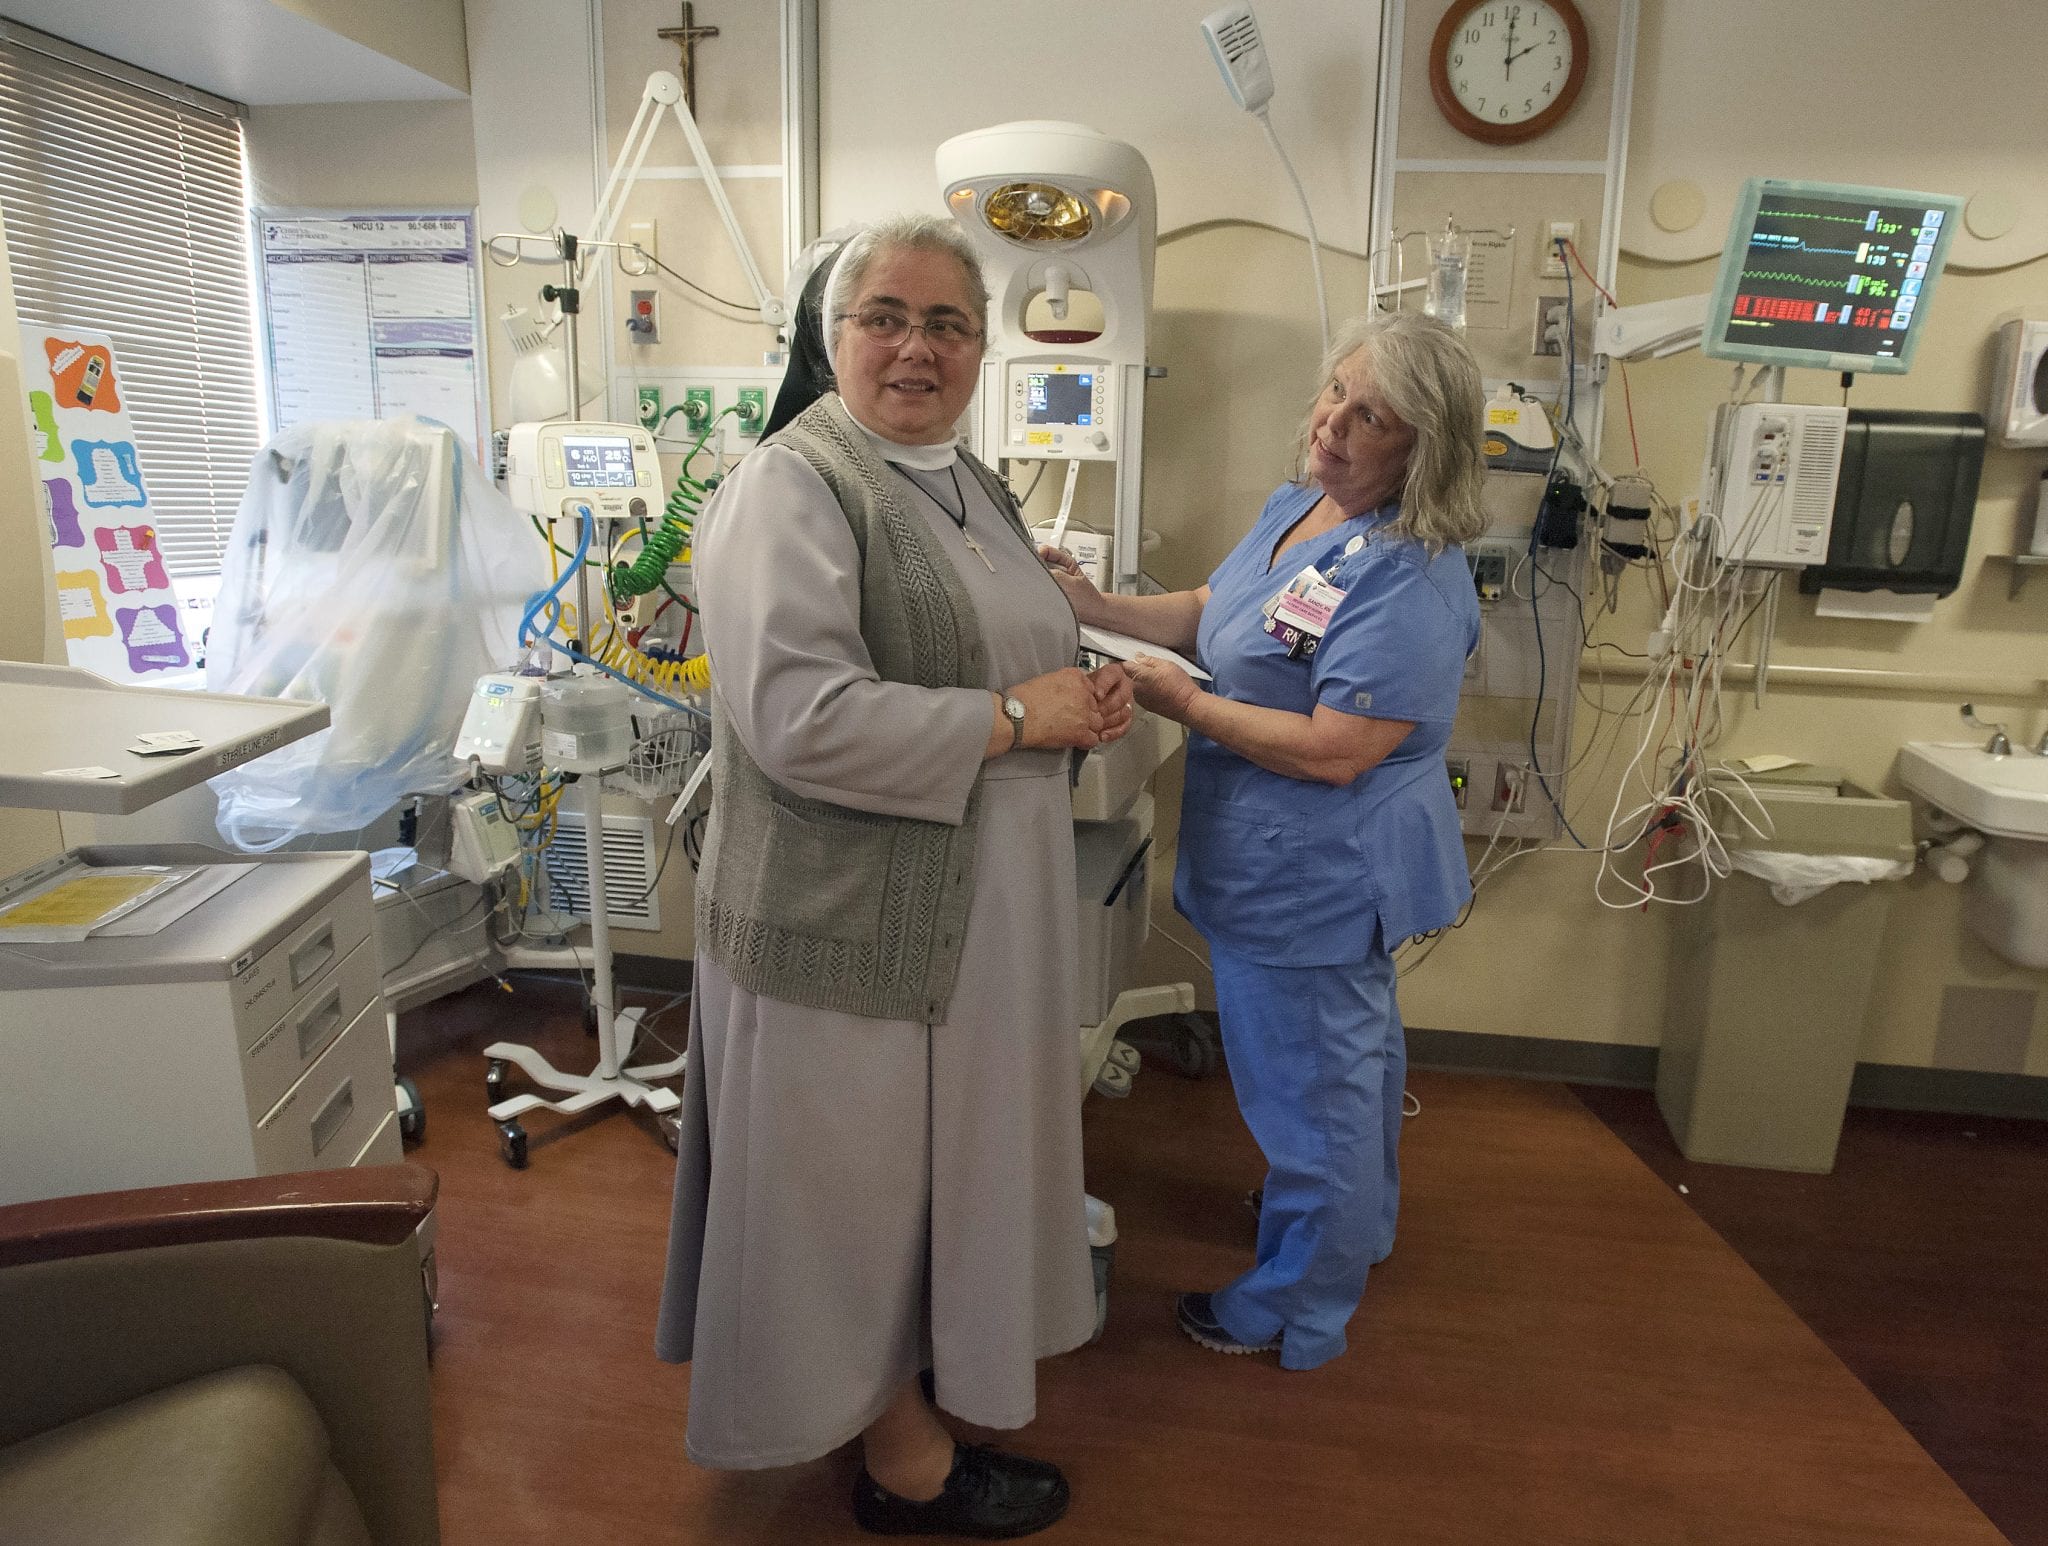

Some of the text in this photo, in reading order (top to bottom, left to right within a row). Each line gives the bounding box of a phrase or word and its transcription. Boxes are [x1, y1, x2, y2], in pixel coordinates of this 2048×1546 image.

[1482, 12, 1495, 27] 11
[1532, 11, 1538, 26] 1
[1464, 29, 1480, 44] 10
[1547, 29, 1557, 45] 2
[1454, 55, 1463, 68] 9
[1553, 55, 1562, 70] 3
[1542, 81, 1551, 95] 4
[1478, 97, 1486, 112] 7
[1499, 104, 1508, 118] 6
[1524, 98, 1532, 113] 5
[352, 222, 373, 231] NICU
